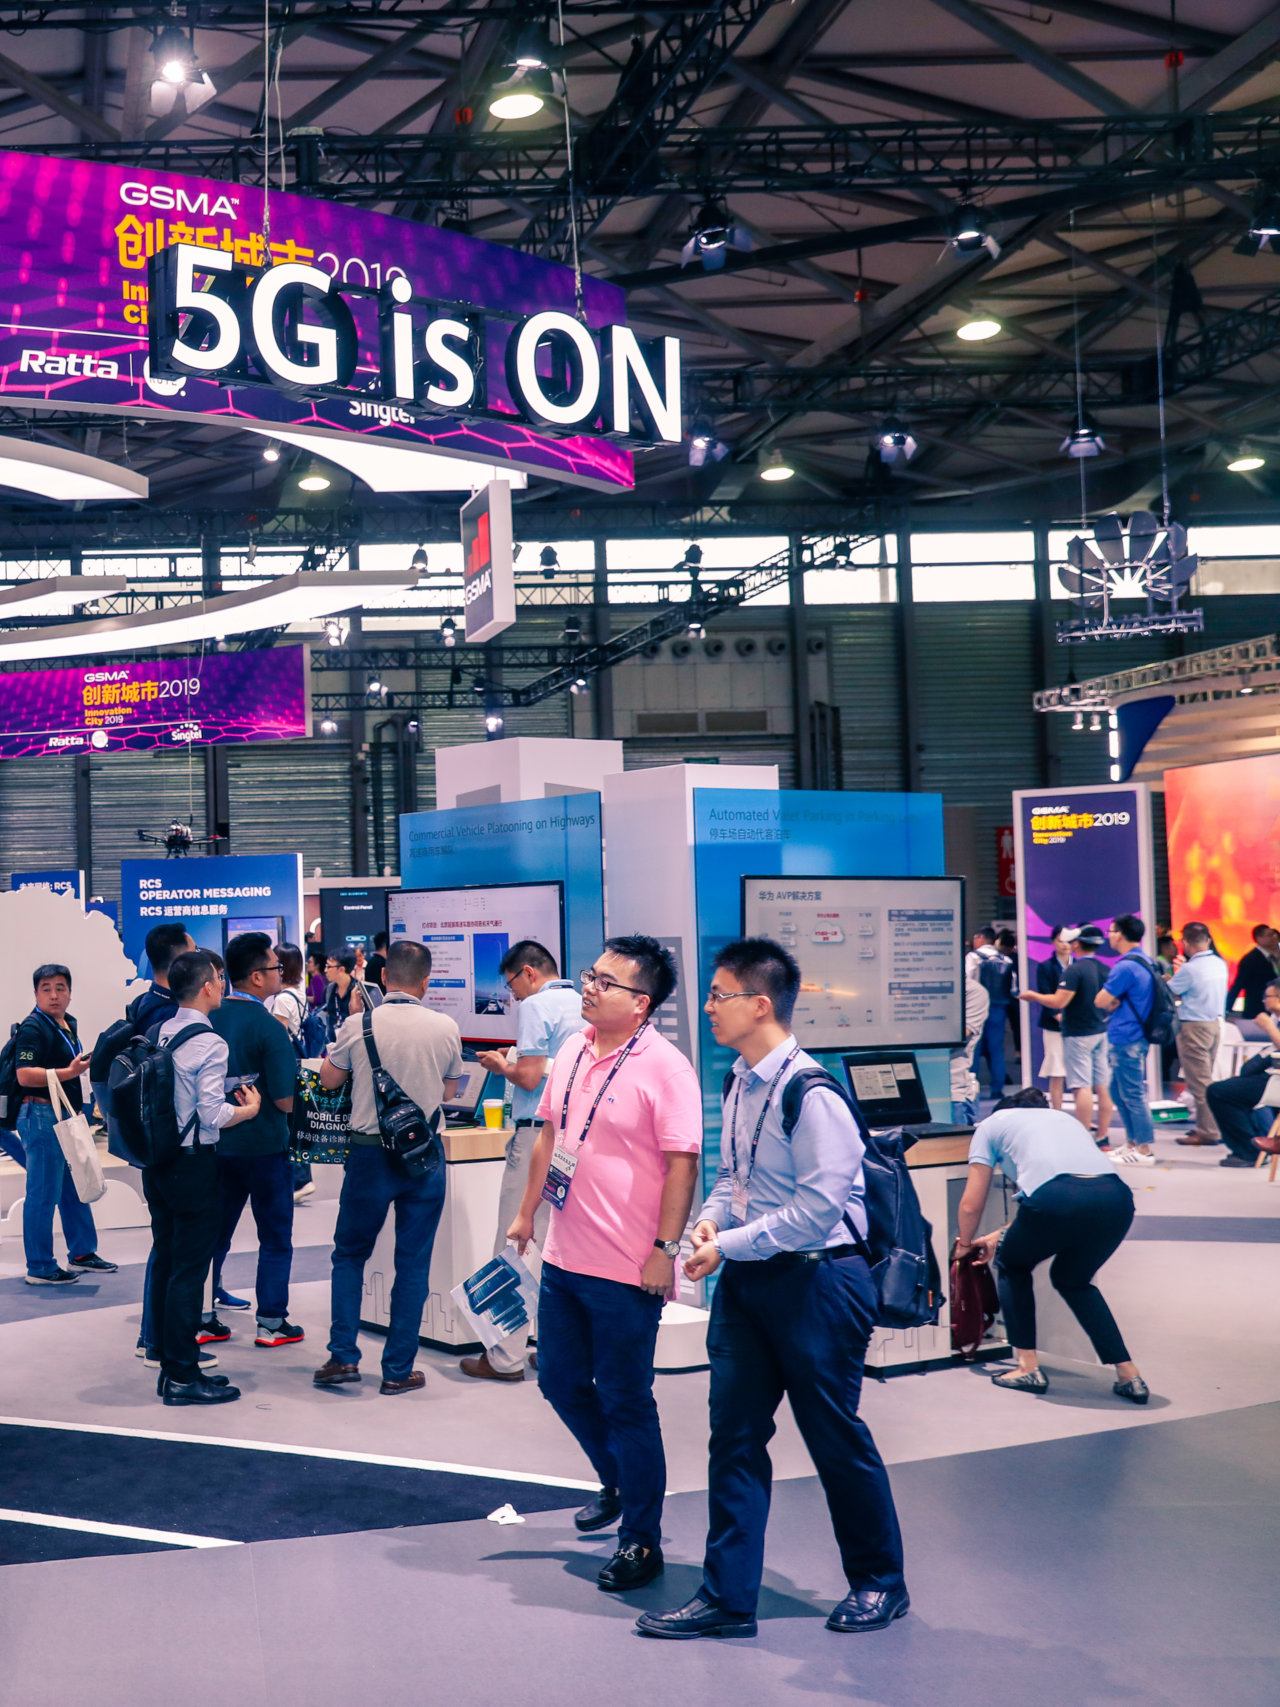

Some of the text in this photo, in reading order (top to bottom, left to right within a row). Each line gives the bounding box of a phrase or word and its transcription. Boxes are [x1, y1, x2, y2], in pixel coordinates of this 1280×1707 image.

[171, 242, 682, 444] 5G is ON
[20, 349, 119, 380] Ratta
[84, 706, 133, 718] Innovation
[84, 715, 124, 726] City 2019
[48, 736, 84, 747] Ratta
[171, 730, 202, 742] Singtel
[708, 808, 769, 822] Automated
[408, 814, 595, 842] Commercial Vehicle Platooning on Highways
[53, 881, 72, 890] RCS
[139, 879, 163, 889] RCS
[139, 886, 272, 900] OPERATOR MESSAGING
[140, 906, 163, 916] RCS
[19, 1051, 34, 1060] 26
[306, 1110, 341, 1122] MOBILE
[310, 1120, 352, 1132] DIAGNOS
